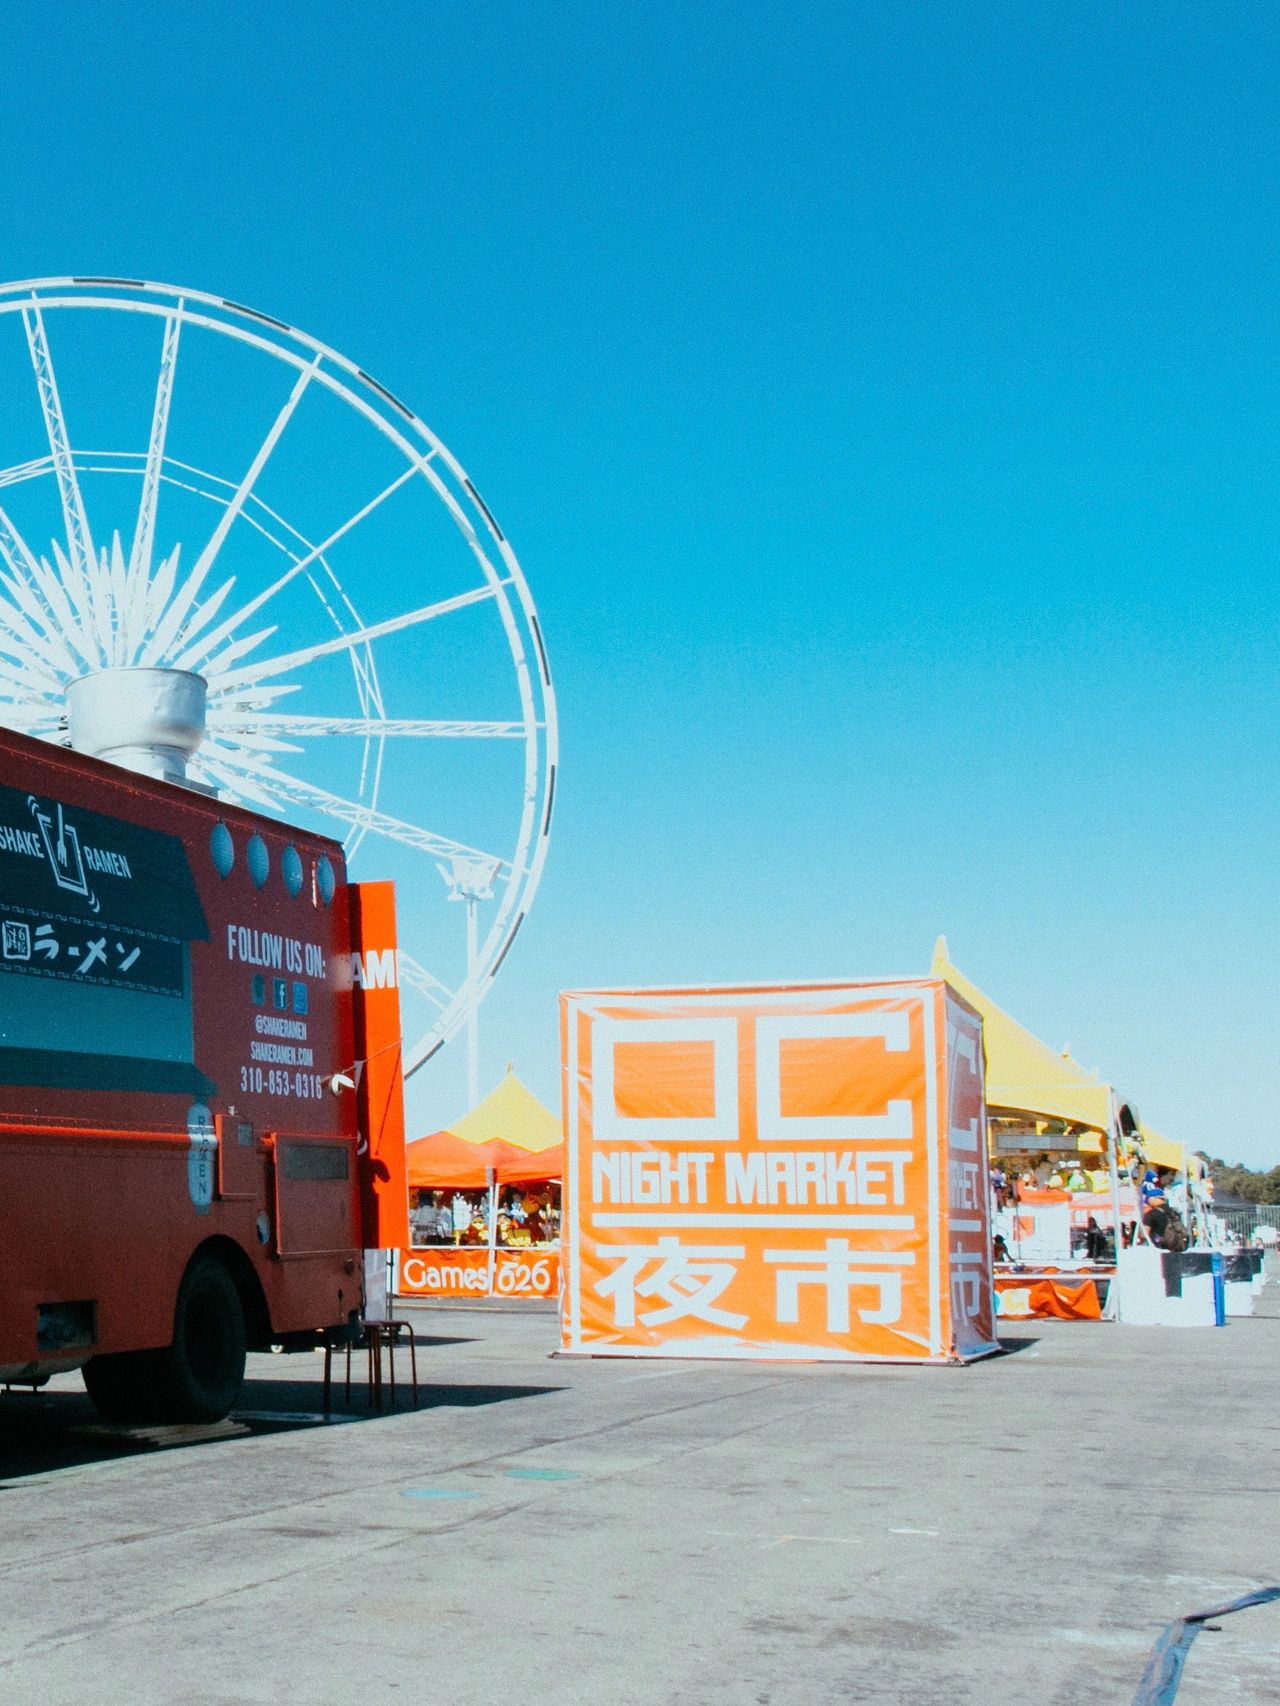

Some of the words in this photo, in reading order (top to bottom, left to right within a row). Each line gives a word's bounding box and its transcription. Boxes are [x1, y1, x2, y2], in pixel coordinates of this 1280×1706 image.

[83, 846, 132, 879] RAMEN
[34, 923, 141, 974] ラーメン
[227, 924, 283, 970] FOLLOW
[285, 937, 303, 974] US
[305, 943, 326, 979] ON:
[350, 948, 400, 990] AM
[255, 1014, 307, 1041] @SHAKERAMEN
[250, 1041, 314, 1067] SHAKERAMEN.COM
[240, 1066, 323, 1099] 310-853-0316
[591, 1012, 913, 1141] OC
[592, 1151, 714, 1203] NIGHT
[724, 1151, 913, 1204] MARKET
[404, 1258, 490, 1291] Games
[593, 1236, 916, 1333] 夜市
